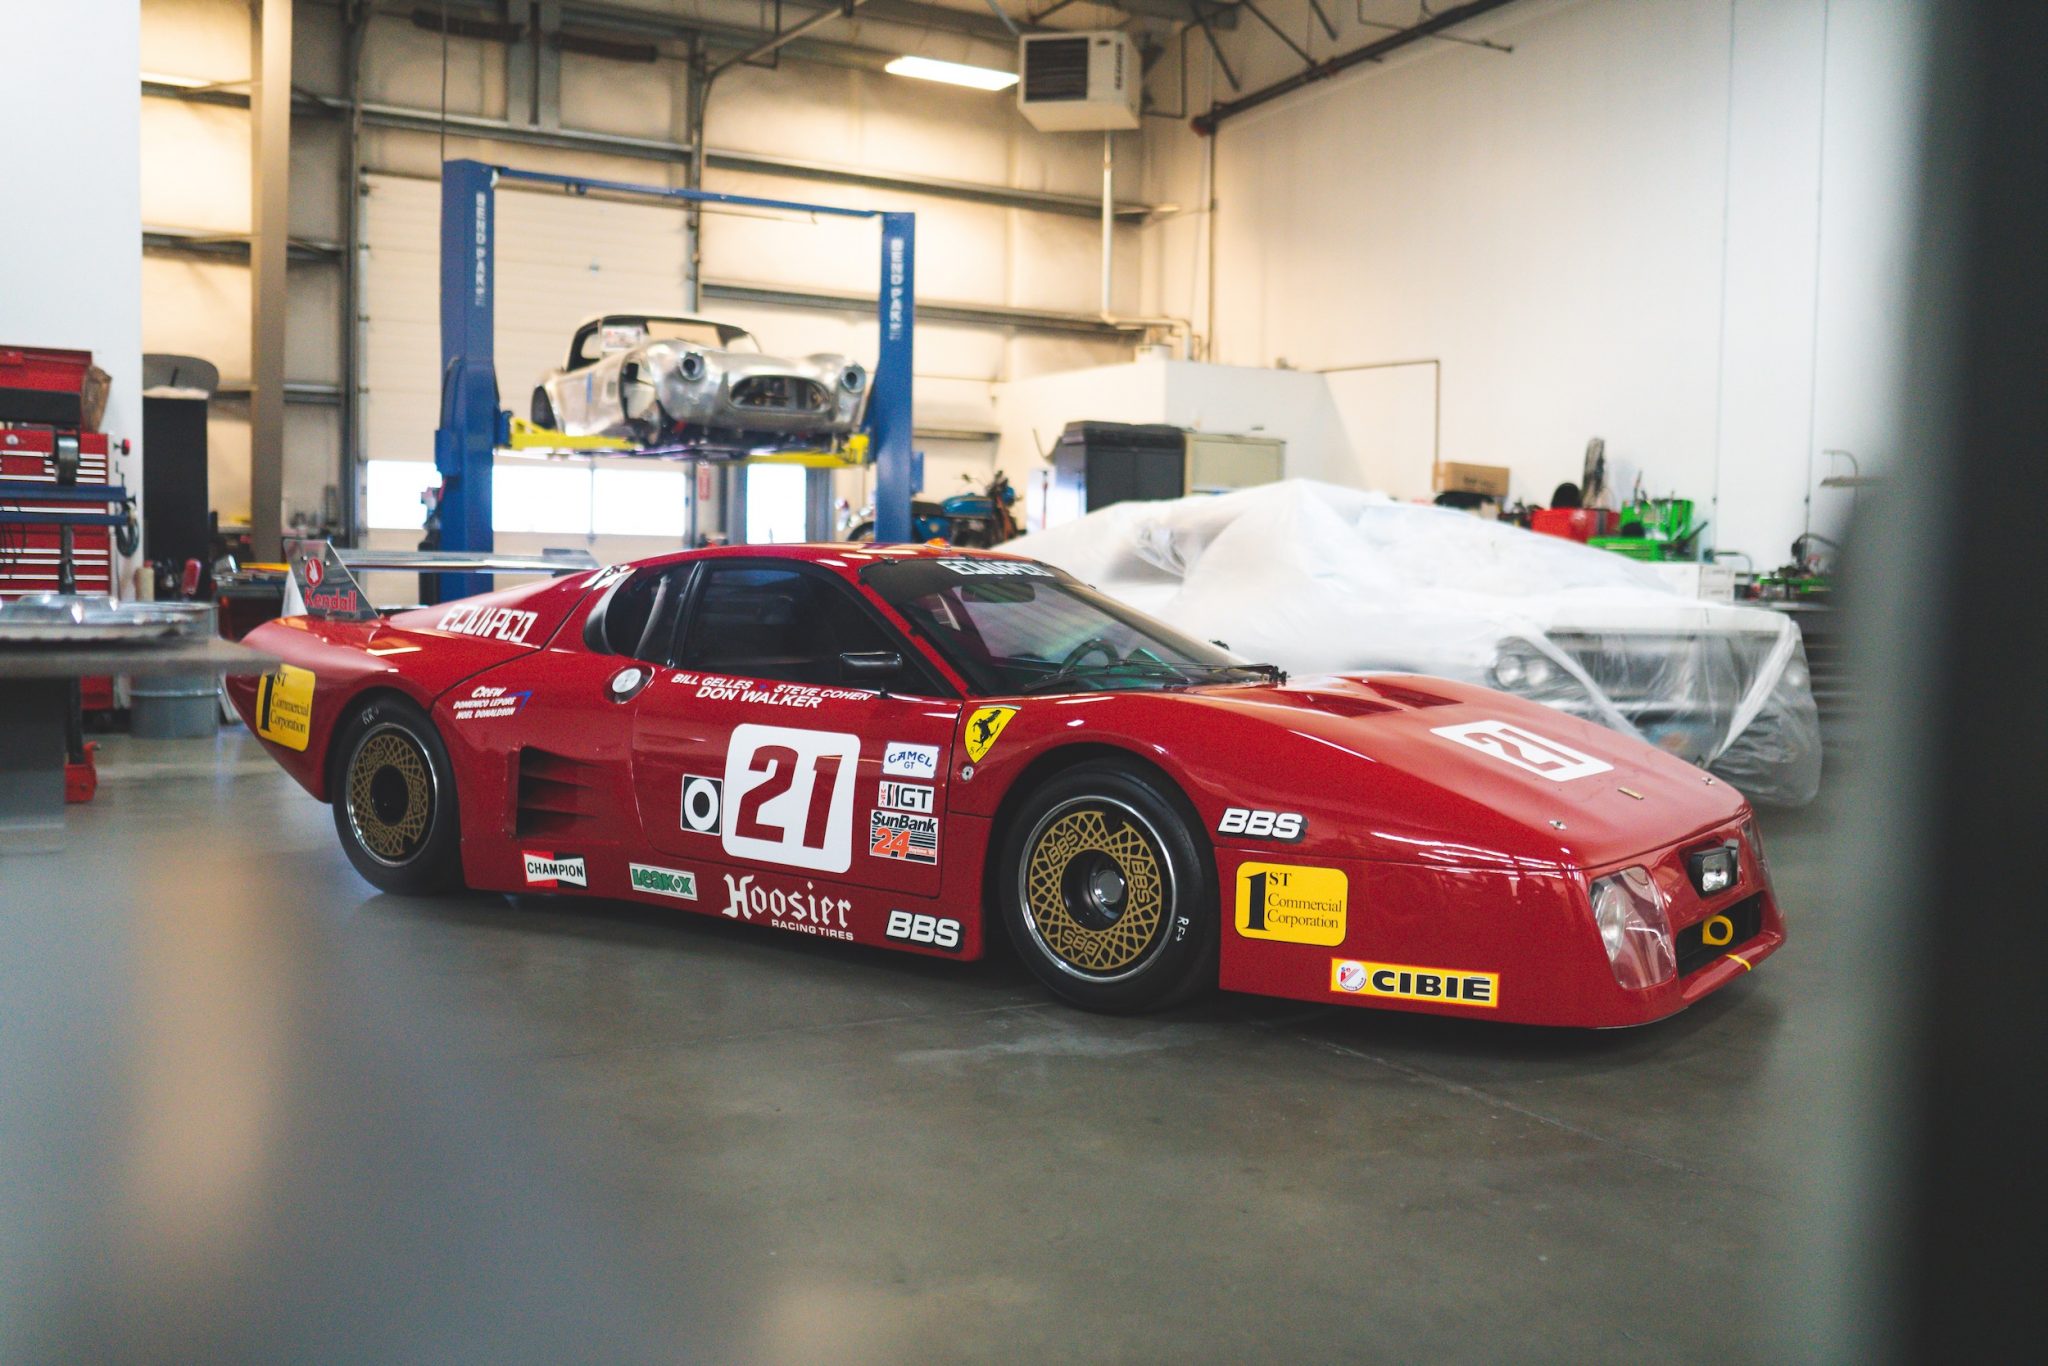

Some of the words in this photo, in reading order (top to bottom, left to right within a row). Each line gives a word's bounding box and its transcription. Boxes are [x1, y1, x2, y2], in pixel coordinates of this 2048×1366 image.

[304, 587, 357, 613] Kendall
[436, 603, 539, 643] EQUIPCO
[671, 673, 699, 685] BILL
[701, 677, 754, 690] GELLES
[773, 684, 822, 696] STEVE
[821, 689, 872, 701] COHEN
[695, 686, 738, 700] DON
[740, 690, 823, 709] WALKER
[272, 692, 309, 716] Commercial
[270, 709, 306, 733] Corporation
[888, 751, 933, 768] CAMEL
[1463, 728, 1585, 772] 21
[903, 761, 915, 769] GT
[735, 745, 844, 850] 21
[900, 788, 932, 809] GT
[872, 811, 936, 833] SunBank
[1217, 807, 1303, 839] BBS
[873, 827, 911, 858] 24
[1049, 828, 1079, 865] BBS
[527, 862, 584, 878] CHAMPION
[1131, 861, 1150, 904] BBS
[722, 873, 852, 929] Hoosier
[1268, 892, 1342, 913] Commercial
[771, 919, 817, 935] RACING
[818, 926, 854, 941] TIRES
[886, 910, 960, 948] BBS
[1267, 908, 1339, 929] Corporation
[1062, 929, 1100, 957] BBS
